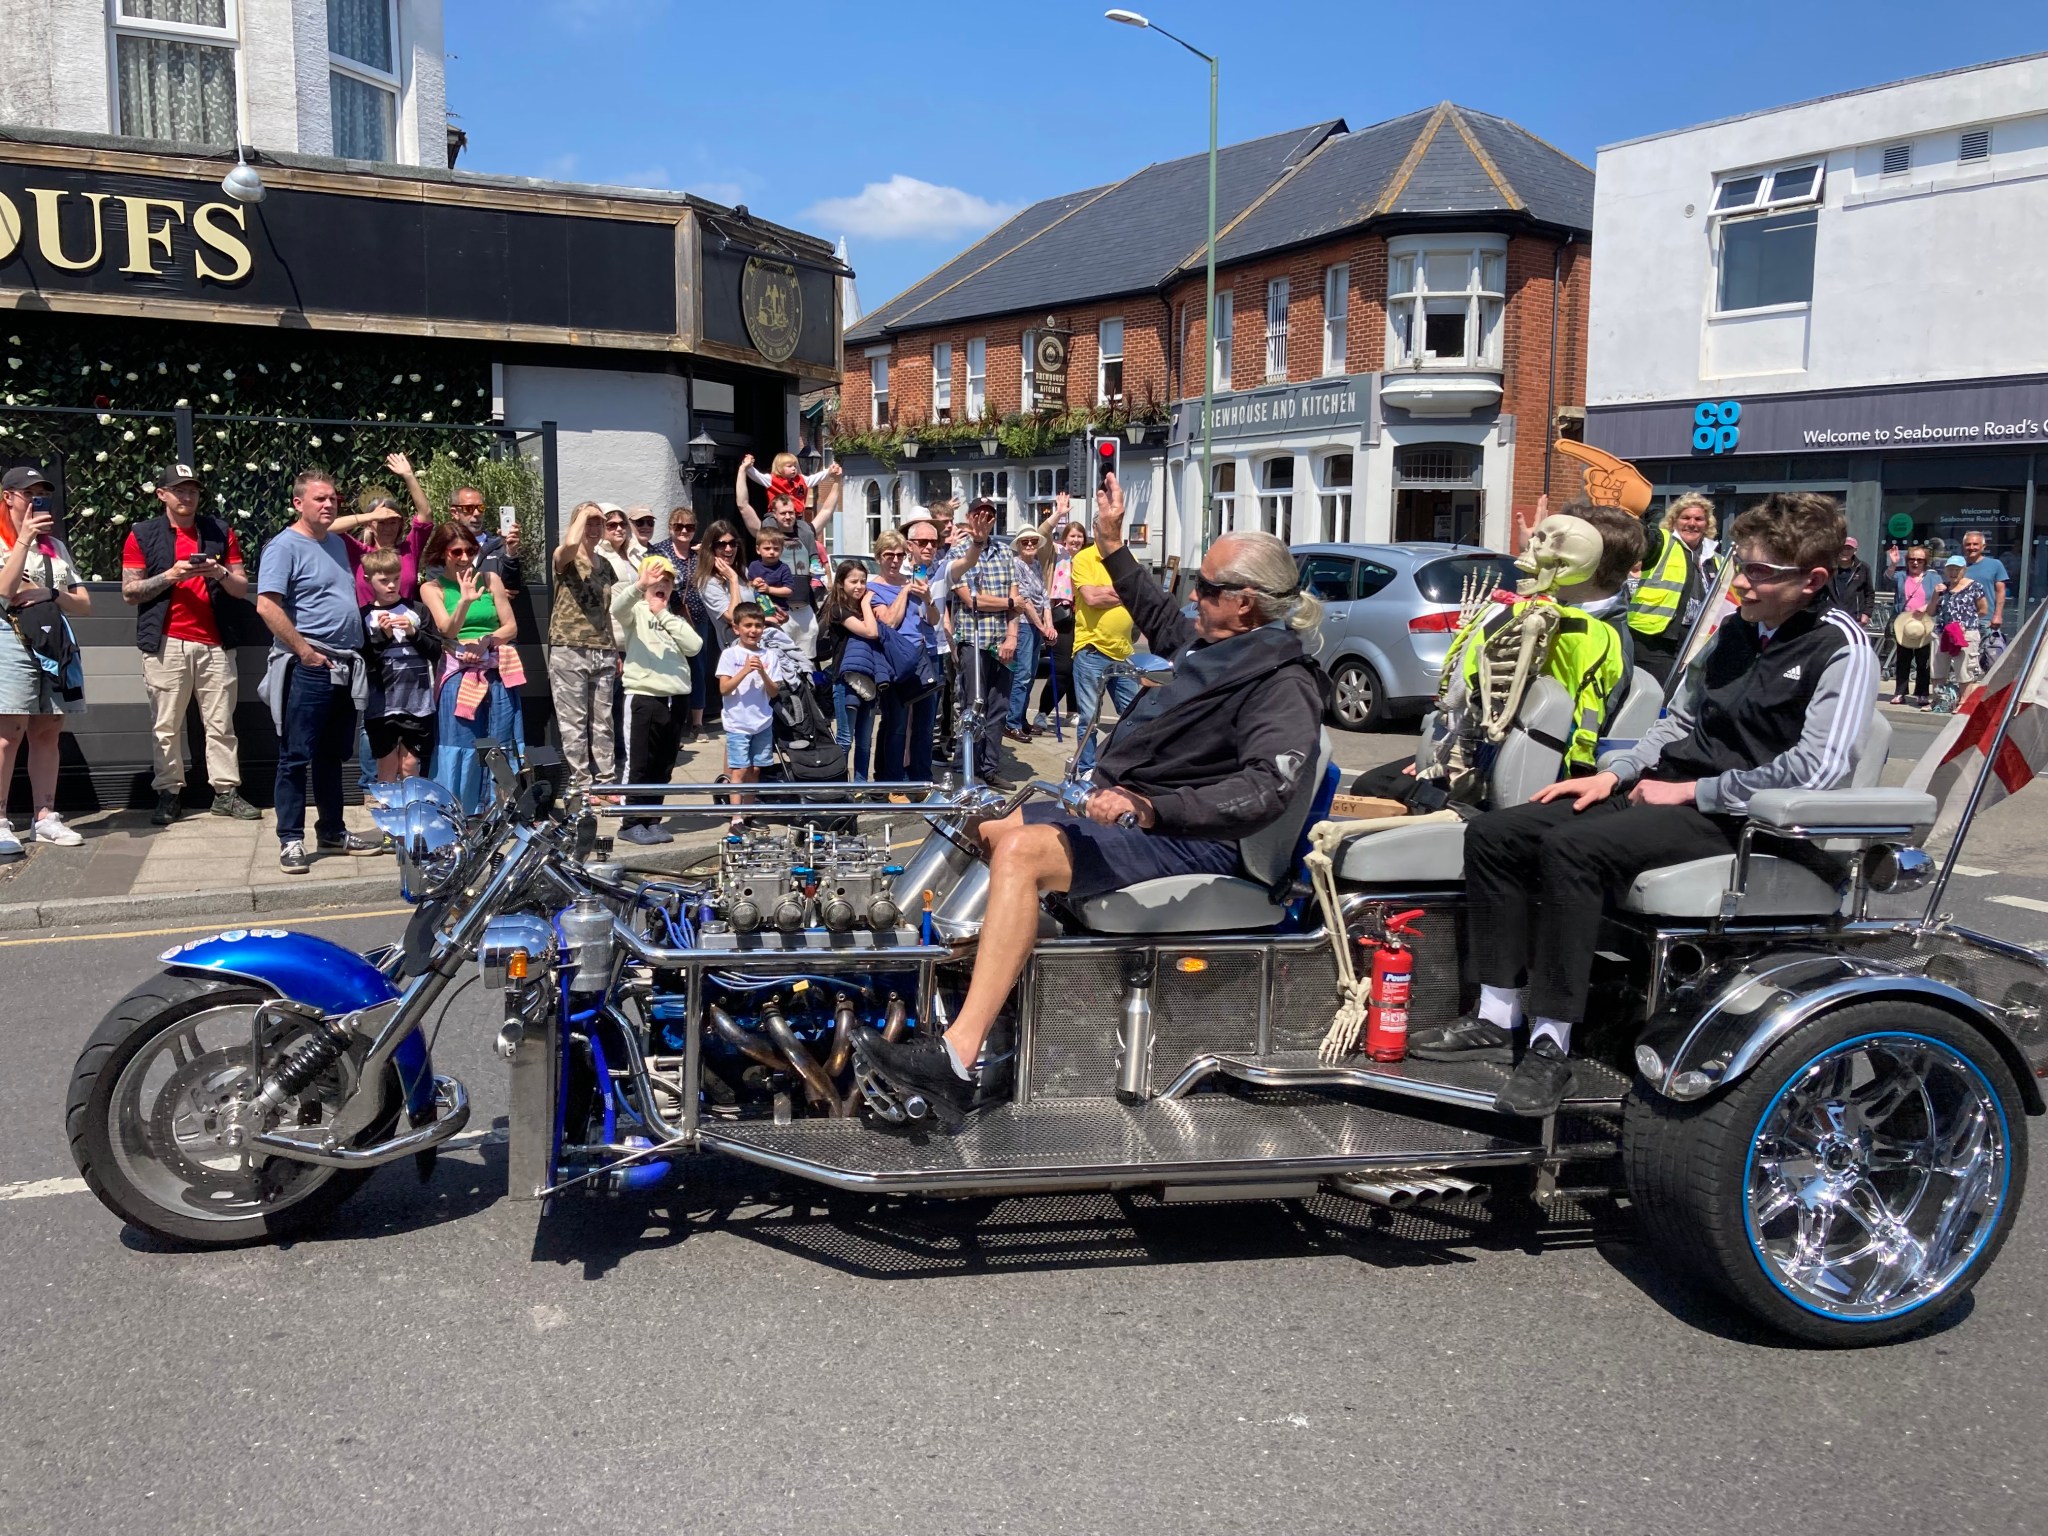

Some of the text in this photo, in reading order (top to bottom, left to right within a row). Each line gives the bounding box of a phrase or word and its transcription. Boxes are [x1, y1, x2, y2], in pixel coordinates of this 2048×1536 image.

[1035, 371, 1066, 383] BREWHOUSE
[1039, 385, 1061, 394] KITCHEN
[1272, 399, 1296, 421] AND
[1301, 391, 1357, 418] KITCHEN
[1803, 429, 1871, 444] Welcome
[1874, 428, 1890, 440] to
[1893, 424, 1979, 440] Seabourne
[1984, 418, 2038, 436] Road's
[2000, 515, 2021, 524] Co-op
